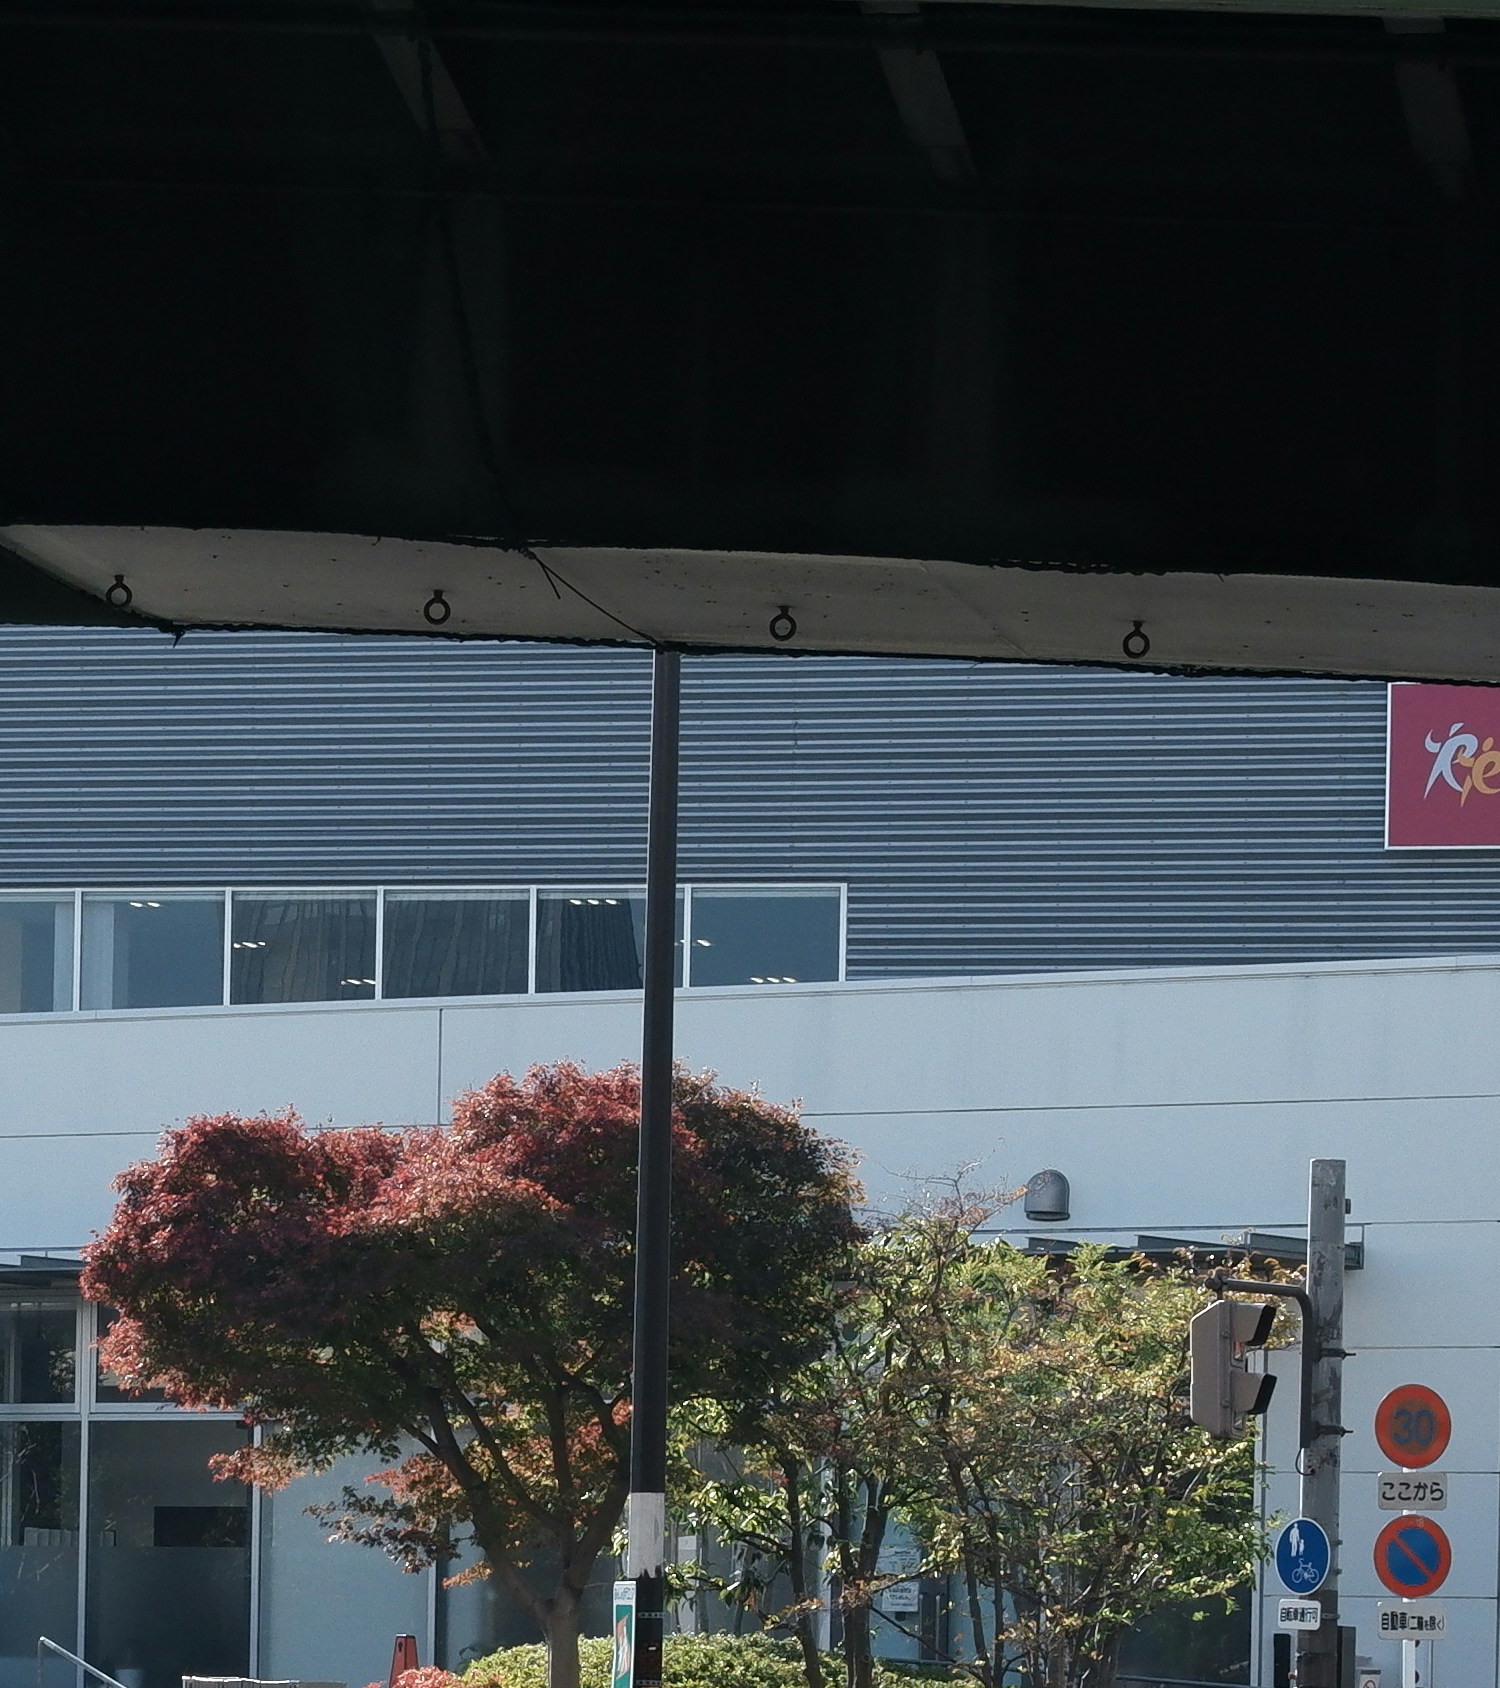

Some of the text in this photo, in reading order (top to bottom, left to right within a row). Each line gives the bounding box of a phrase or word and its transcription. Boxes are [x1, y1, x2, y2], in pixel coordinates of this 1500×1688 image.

[1392, 1408, 1434, 1446] 30
[1381, 1481, 1445, 1501] ここから
